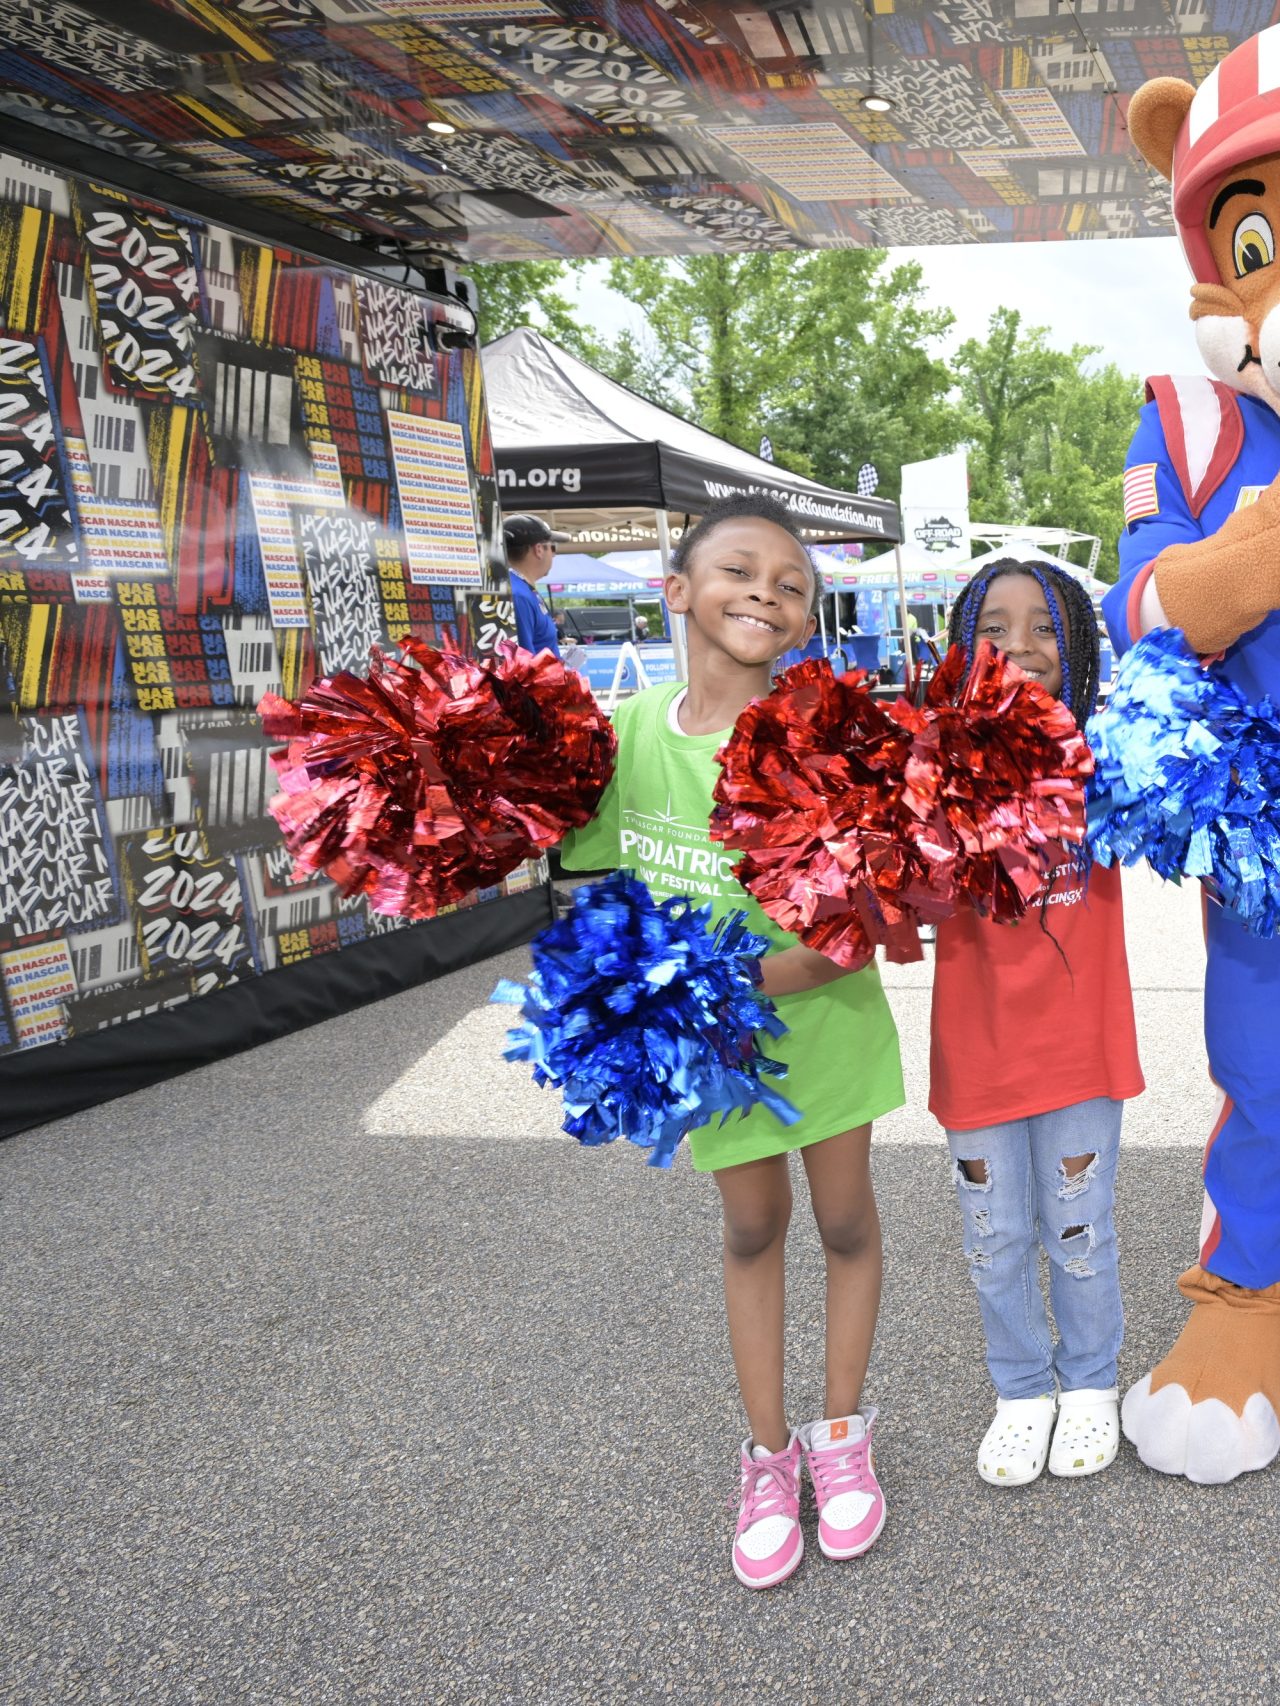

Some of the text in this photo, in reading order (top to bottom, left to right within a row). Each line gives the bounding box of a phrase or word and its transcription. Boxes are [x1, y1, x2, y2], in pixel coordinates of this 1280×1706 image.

[85, 212, 199, 302] 2024
[91, 264, 196, 351] 2024
[365, 310, 425, 342] NASCAR
[364, 338, 426, 368] NASCAR
[391, 422, 460, 440] NASCAR NASCAR NASCAR
[398, 471, 421, 479] NASCAR
[499, 467, 581, 492] n.org
[401, 495, 424, 503] NASCAR
[308, 553, 374, 595] NASCAR
[117, 583, 154, 596] NAS
[119, 593, 157, 606] CAR
[121, 608, 159, 621] NAS
[124, 618, 161, 631] CAR
[132, 661, 169, 673] NAS
[133, 671, 171, 684] CAR
[137, 687, 174, 699] NAS
[139, 697, 176, 710] CAR
[138, 865, 242, 916] 2024
[661, 873, 722, 897] FESTIVAL
[142, 917, 245, 966] 2024
